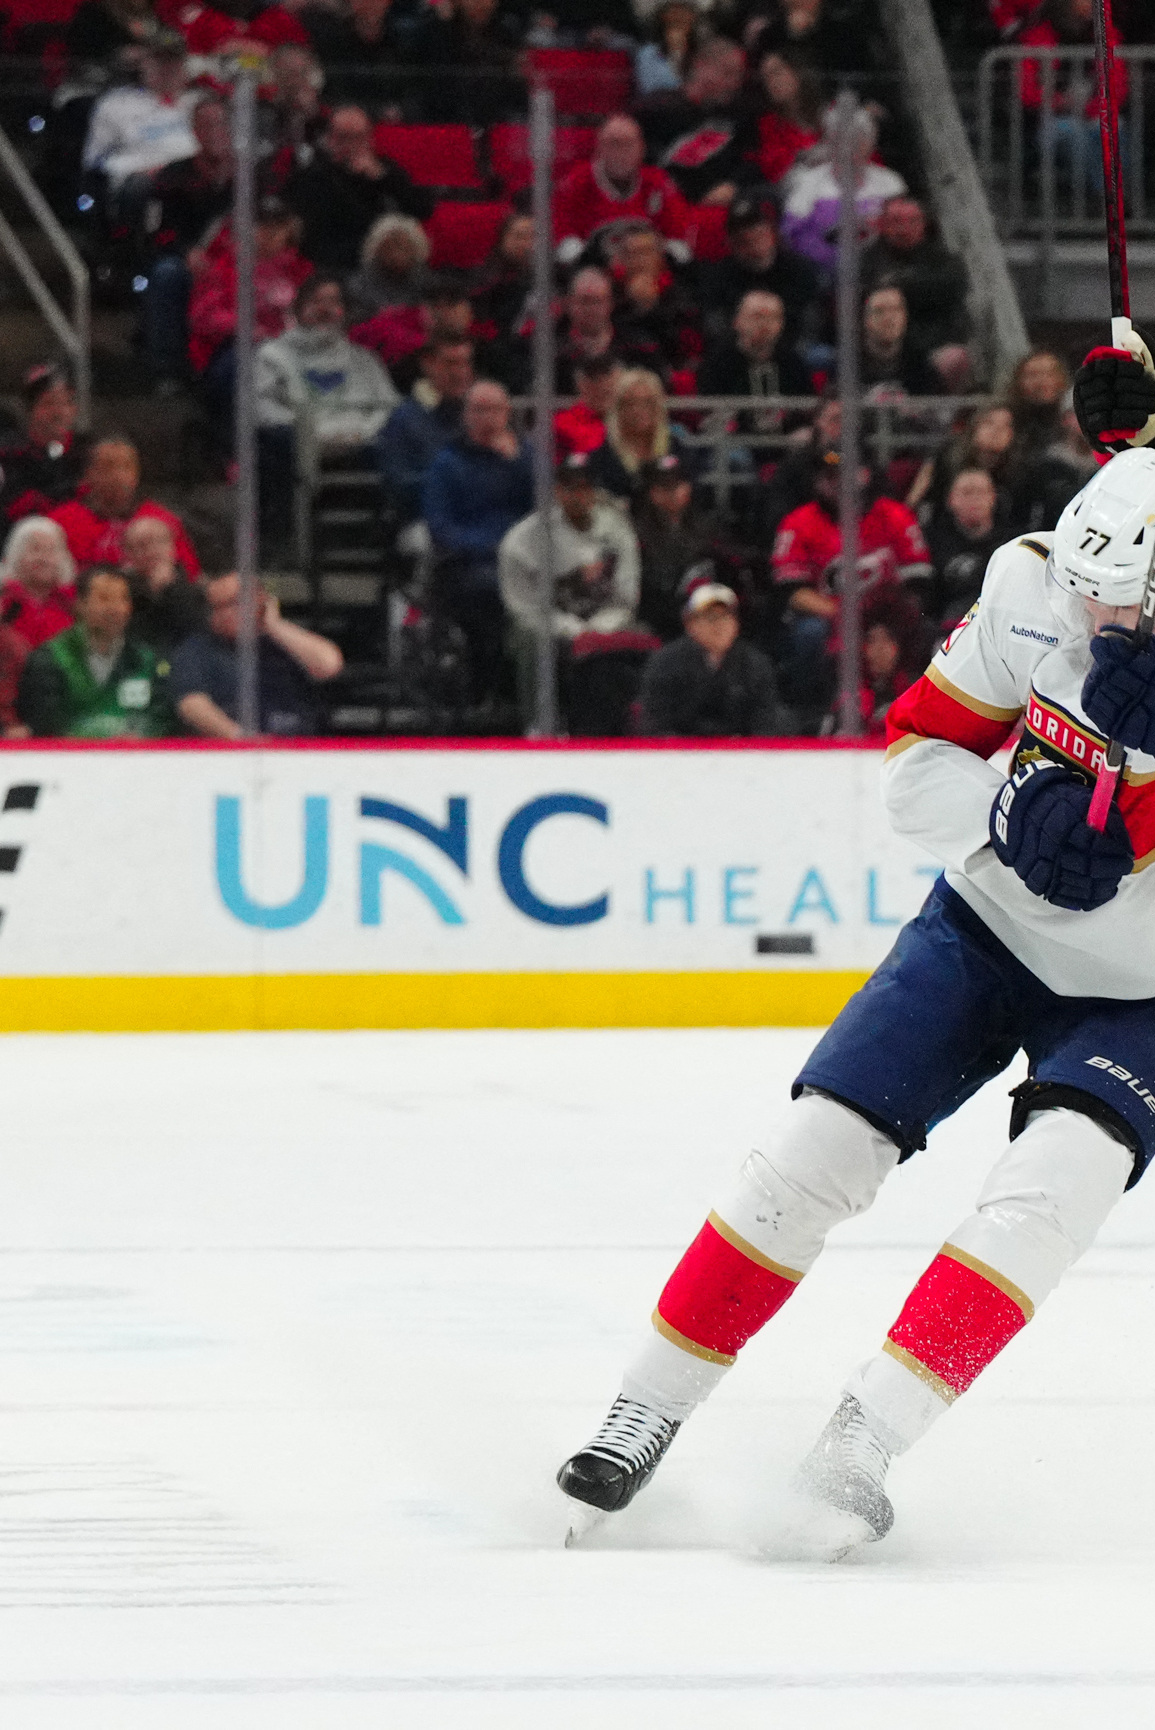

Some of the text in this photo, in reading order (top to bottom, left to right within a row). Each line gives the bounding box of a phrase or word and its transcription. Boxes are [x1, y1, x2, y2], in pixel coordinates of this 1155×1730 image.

[1079, 527, 1111, 557] 77
[1010, 624, 1059, 647] AutoNation
[1026, 697, 1105, 776] LORIDA
[995, 758, 1065, 846] BAUE
[213, 794, 945, 932] UNC HEAL
